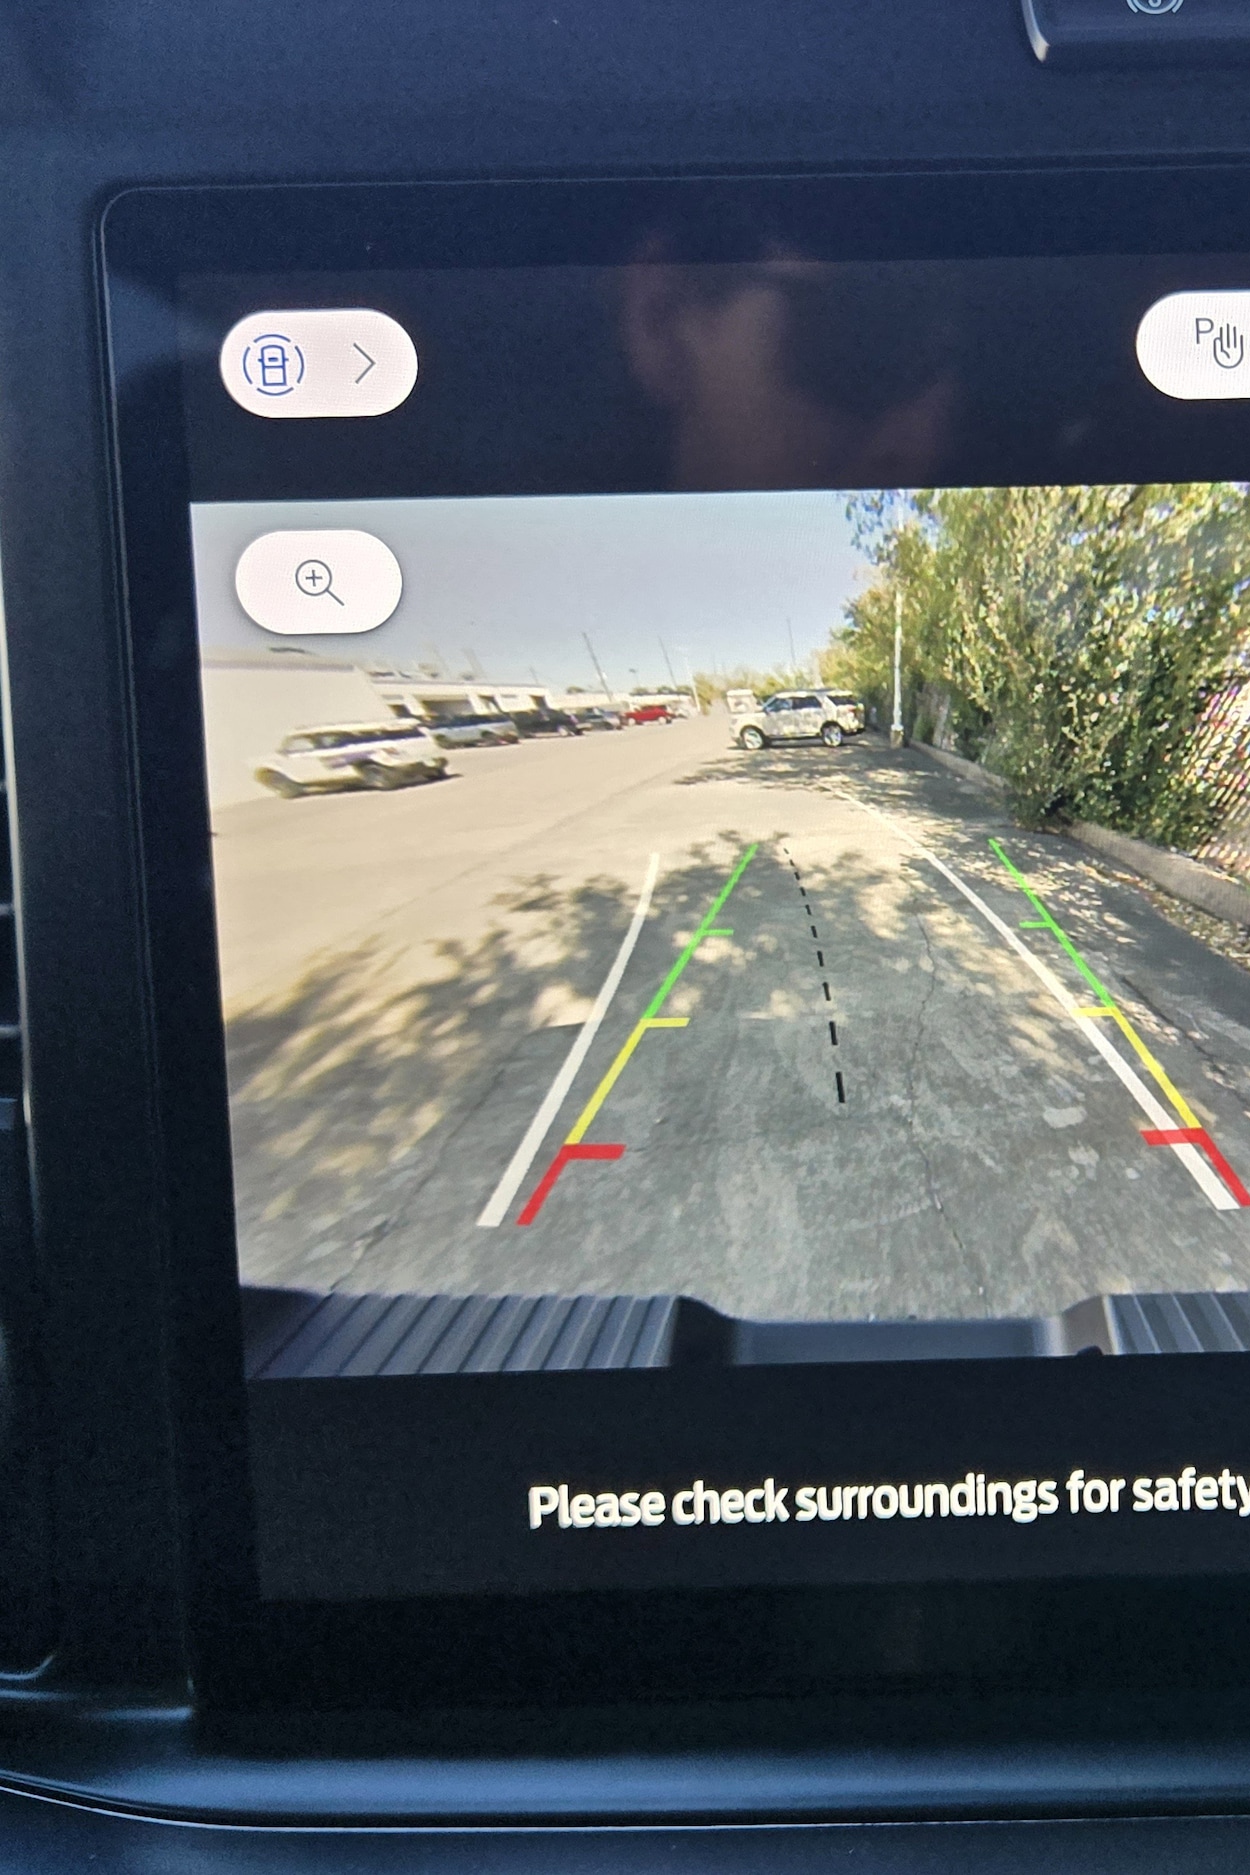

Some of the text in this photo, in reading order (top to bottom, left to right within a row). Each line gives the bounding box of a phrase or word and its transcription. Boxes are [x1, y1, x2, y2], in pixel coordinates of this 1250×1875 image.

[1194, 317, 1214, 345] P
[528, 1483, 666, 1529] Please
[671, 1478, 791, 1525] check
[794, 1472, 1060, 1524] surroundings
[1065, 1469, 1127, 1514] for
